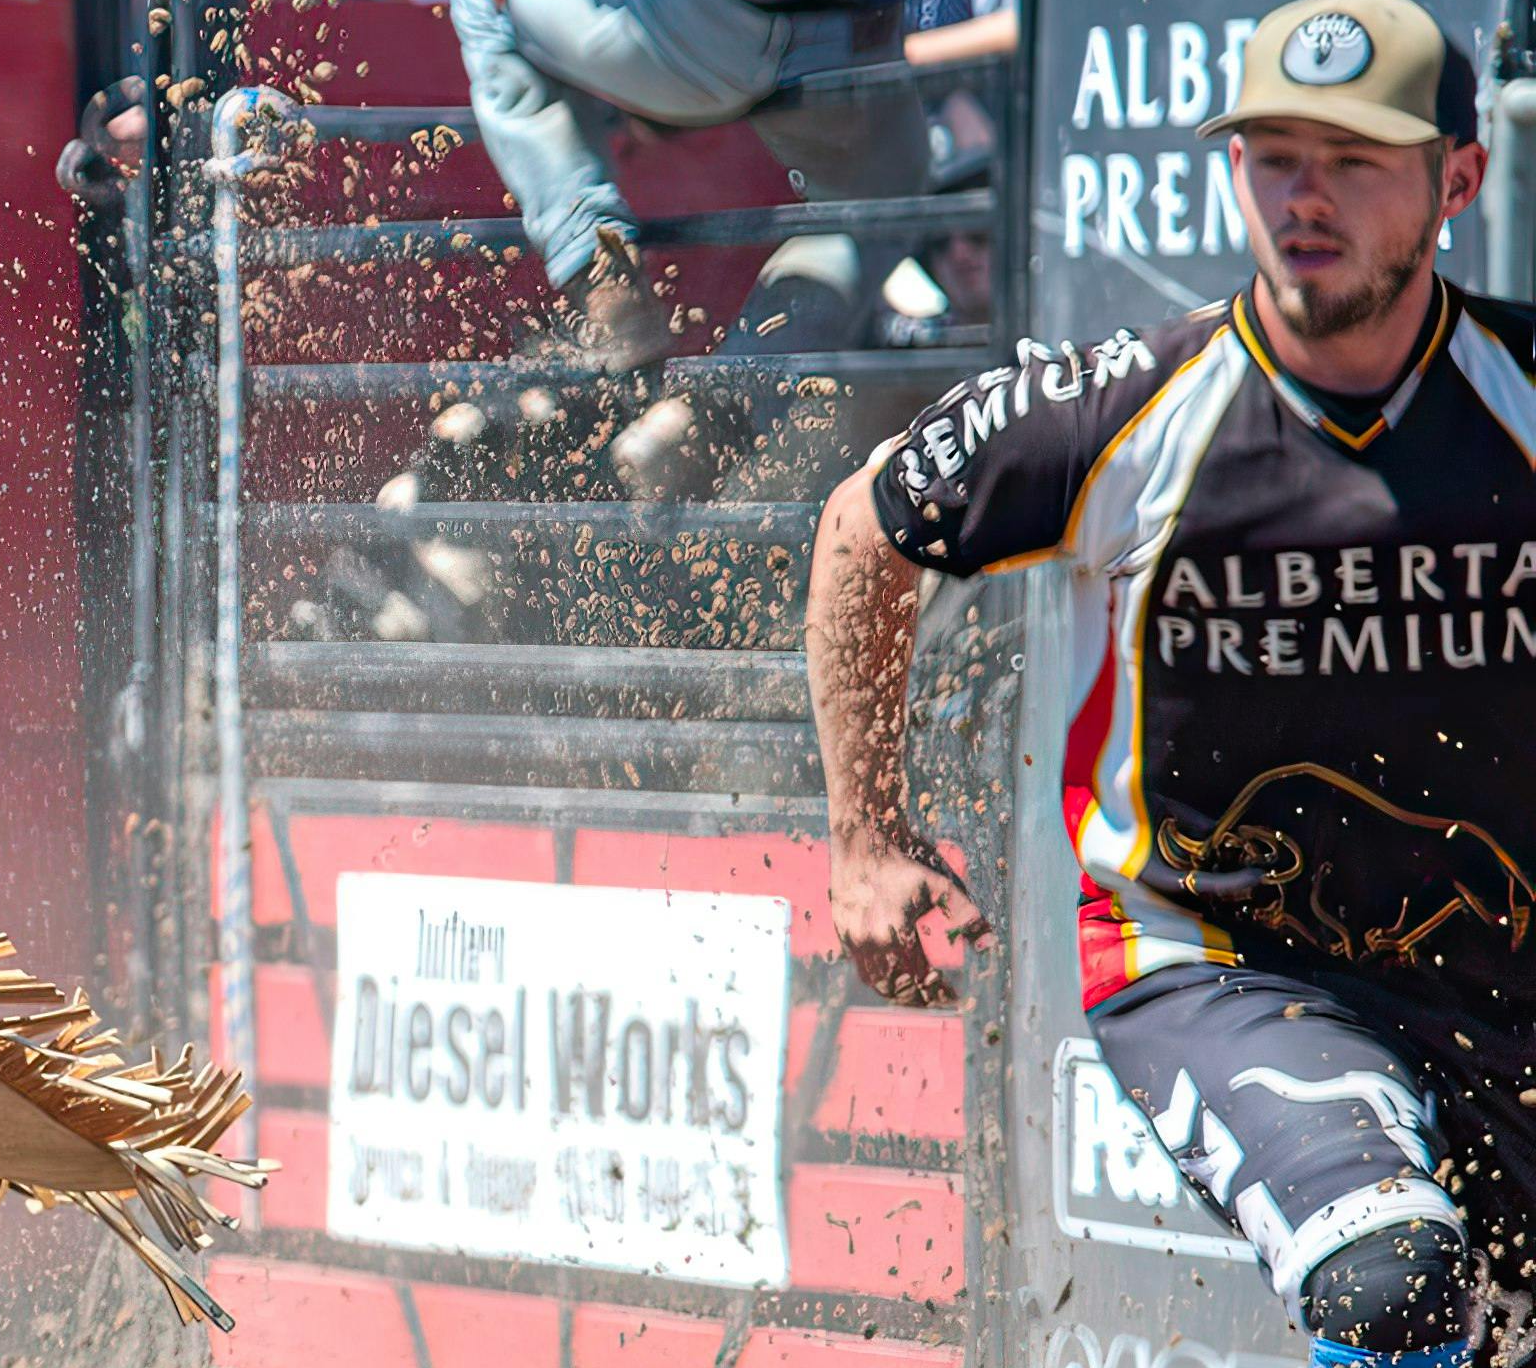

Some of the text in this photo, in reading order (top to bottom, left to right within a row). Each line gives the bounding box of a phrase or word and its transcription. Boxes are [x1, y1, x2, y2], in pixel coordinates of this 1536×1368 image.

[1161, 540, 1536, 609] ALBERTA
[350, 974, 752, 1135] Diesel Works
